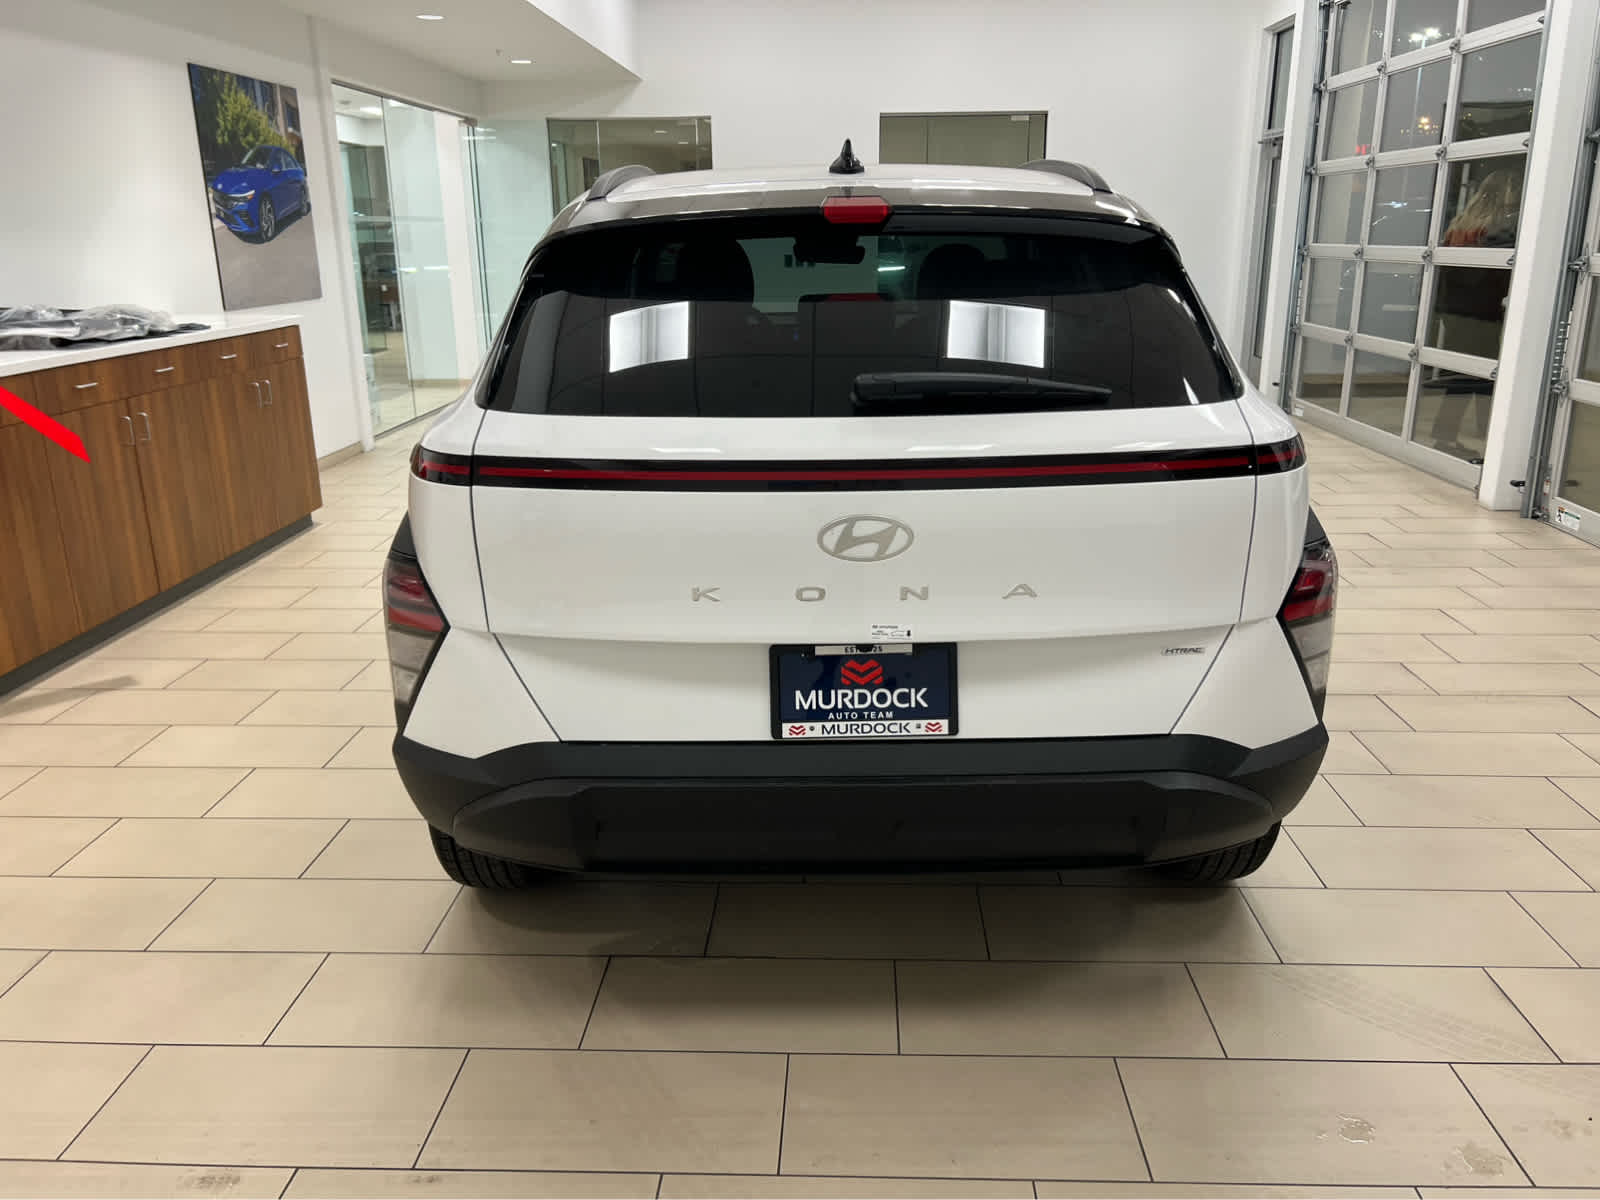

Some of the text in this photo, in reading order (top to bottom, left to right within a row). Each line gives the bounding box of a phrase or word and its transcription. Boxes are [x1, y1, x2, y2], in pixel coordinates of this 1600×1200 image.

[1163, 646, 1205, 656] HTRAC
[795, 687, 928, 710] MURDOCK
[828, 711, 894, 720] AUTO TEAM
[821, 722, 911, 735] MURDOCK
